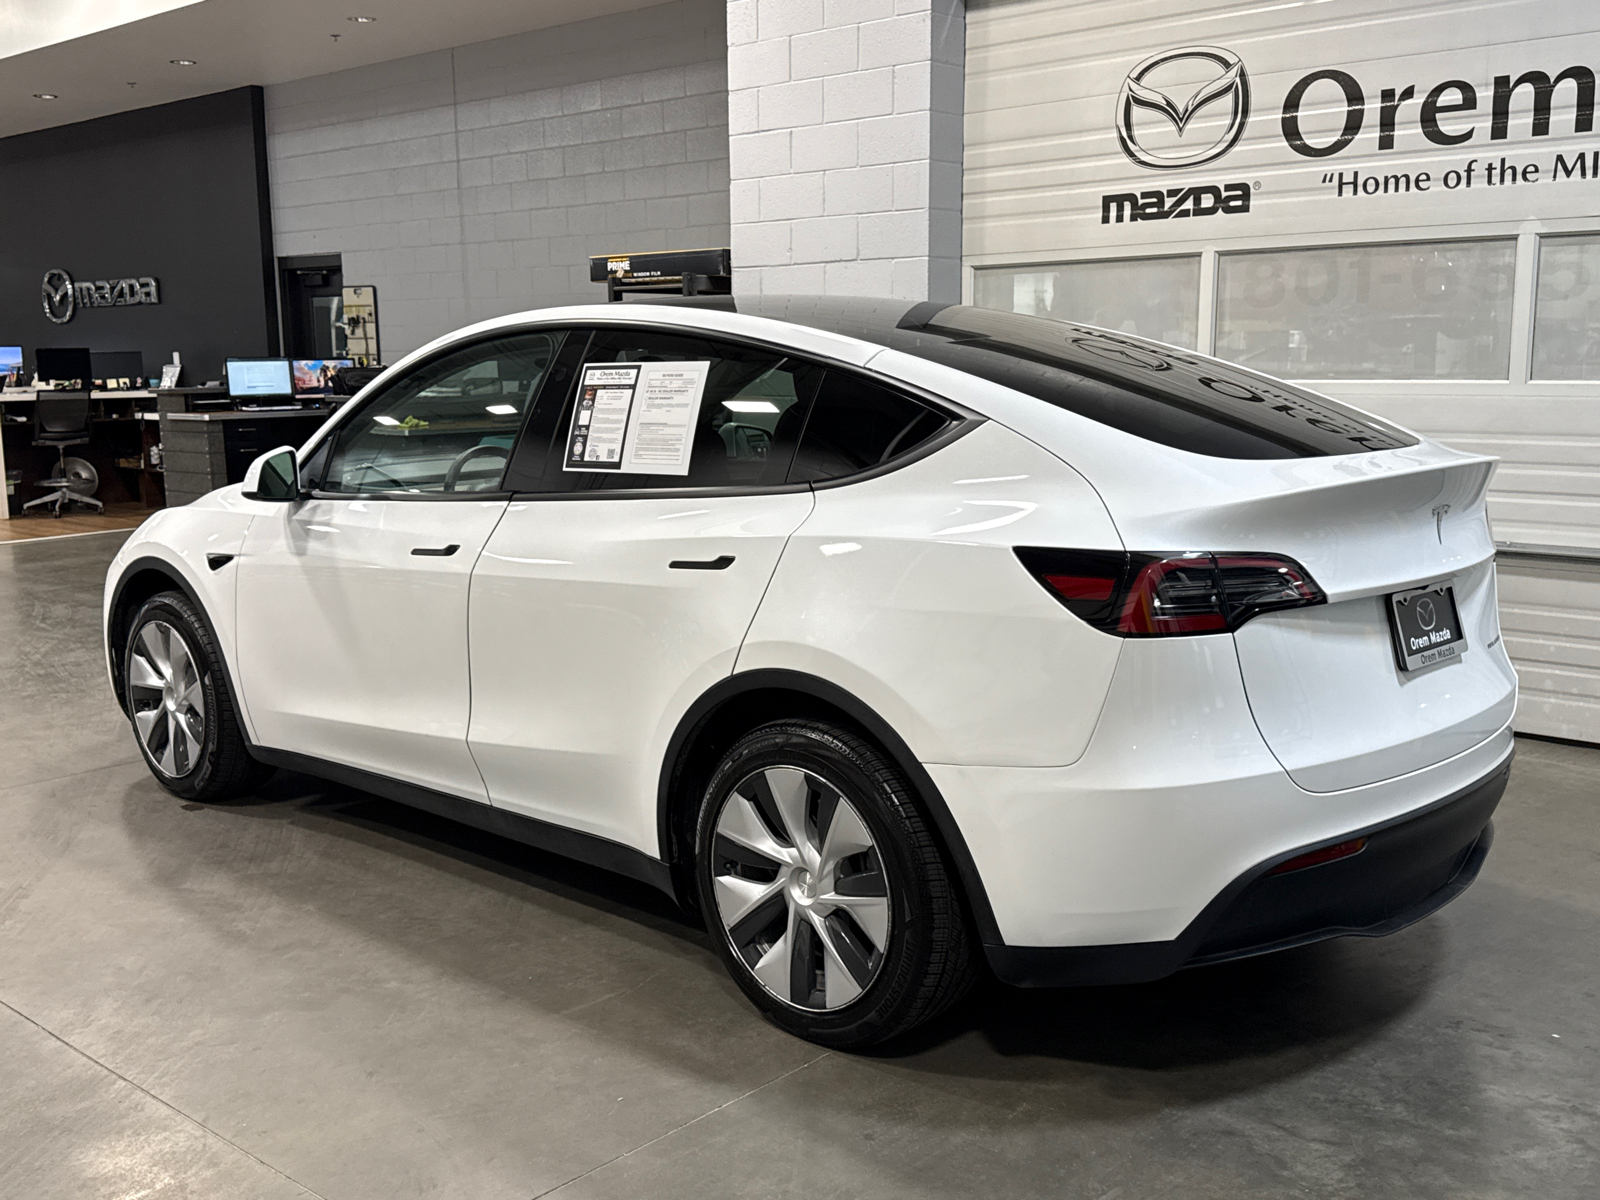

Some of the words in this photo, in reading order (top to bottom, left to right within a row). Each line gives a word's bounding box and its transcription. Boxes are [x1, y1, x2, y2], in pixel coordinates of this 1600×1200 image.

[1281, 65, 1596, 158] Orem
[1443, 159, 1478, 189] of
[1485, 157, 1539, 186] the
[607, 261, 631, 272] PRIME
[1410, 637, 1430, 650] Orem
[1430, 627, 1451, 644] Mazda
[1421, 654, 1437, 665] Orem
[1437, 646, 1456, 659] Mazda
